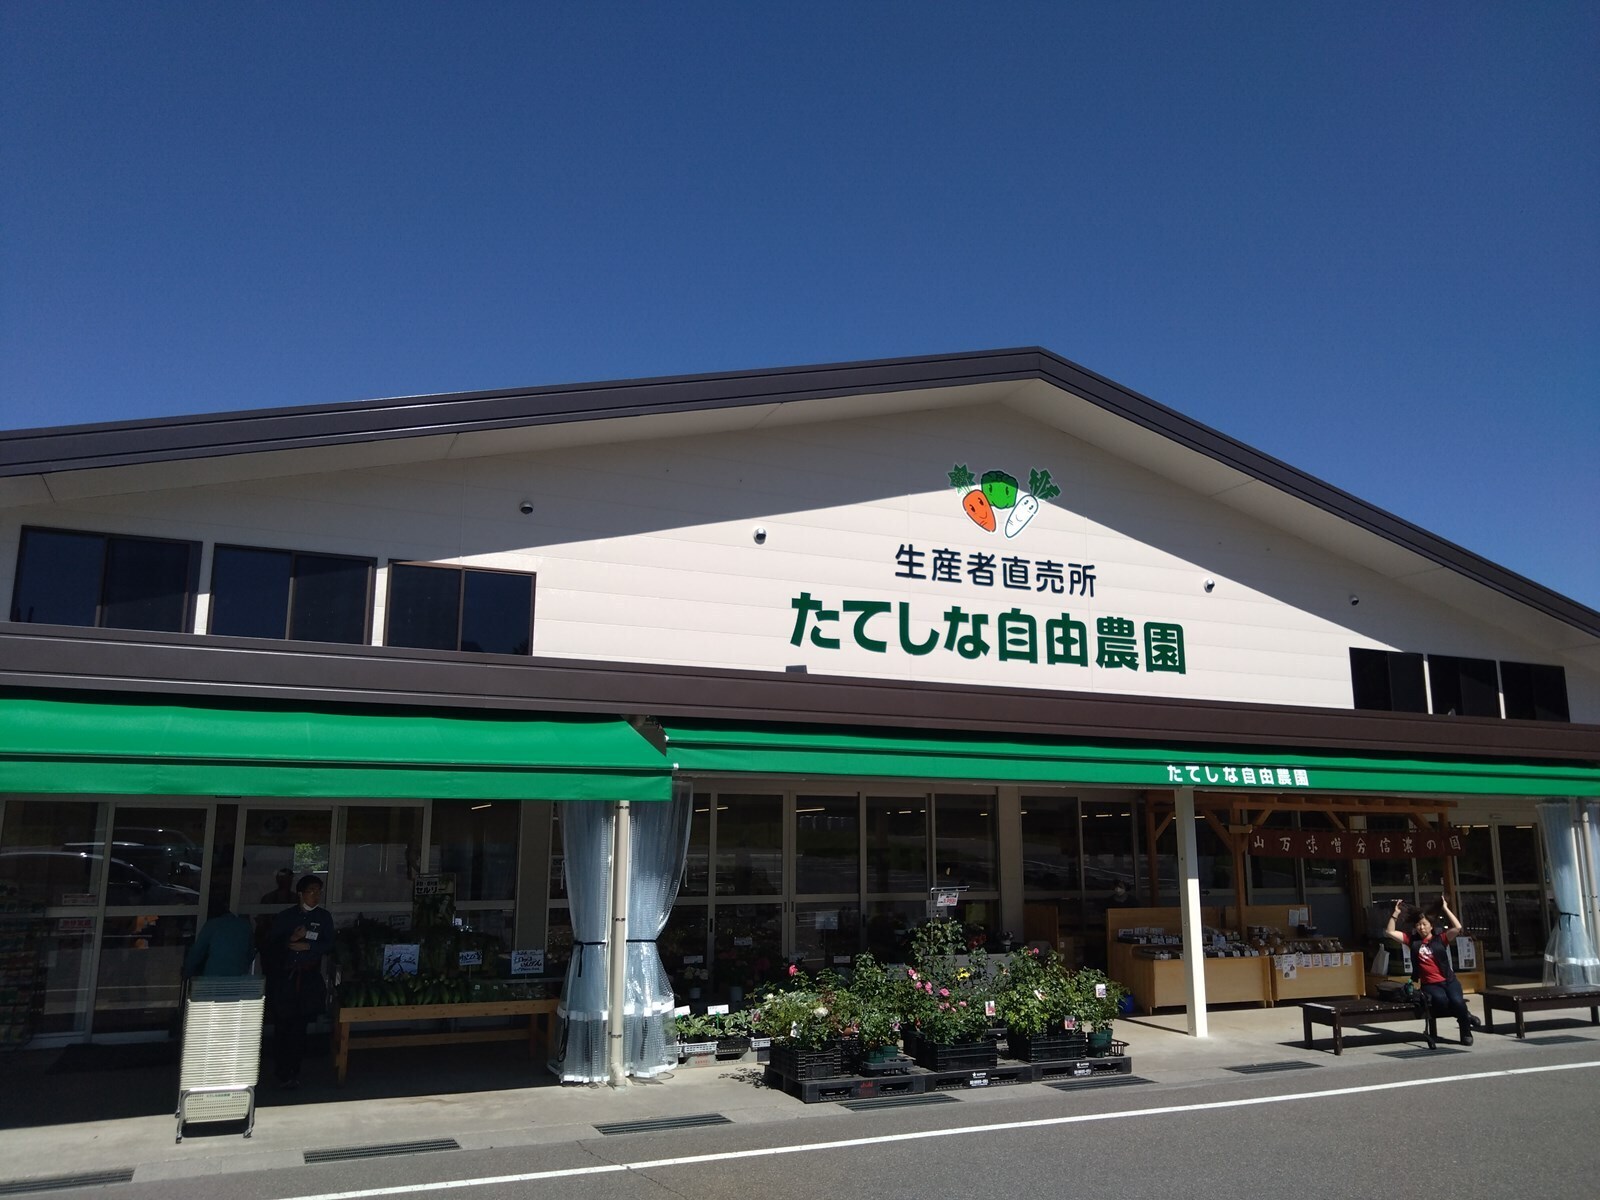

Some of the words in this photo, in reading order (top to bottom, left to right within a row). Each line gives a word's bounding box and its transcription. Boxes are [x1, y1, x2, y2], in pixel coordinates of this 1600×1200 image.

[895, 544, 1097, 598] 生産者直売所
[790, 592, 1187, 675] たてしな自由農園
[1166, 764, 1309, 786] たてしな自由農園
